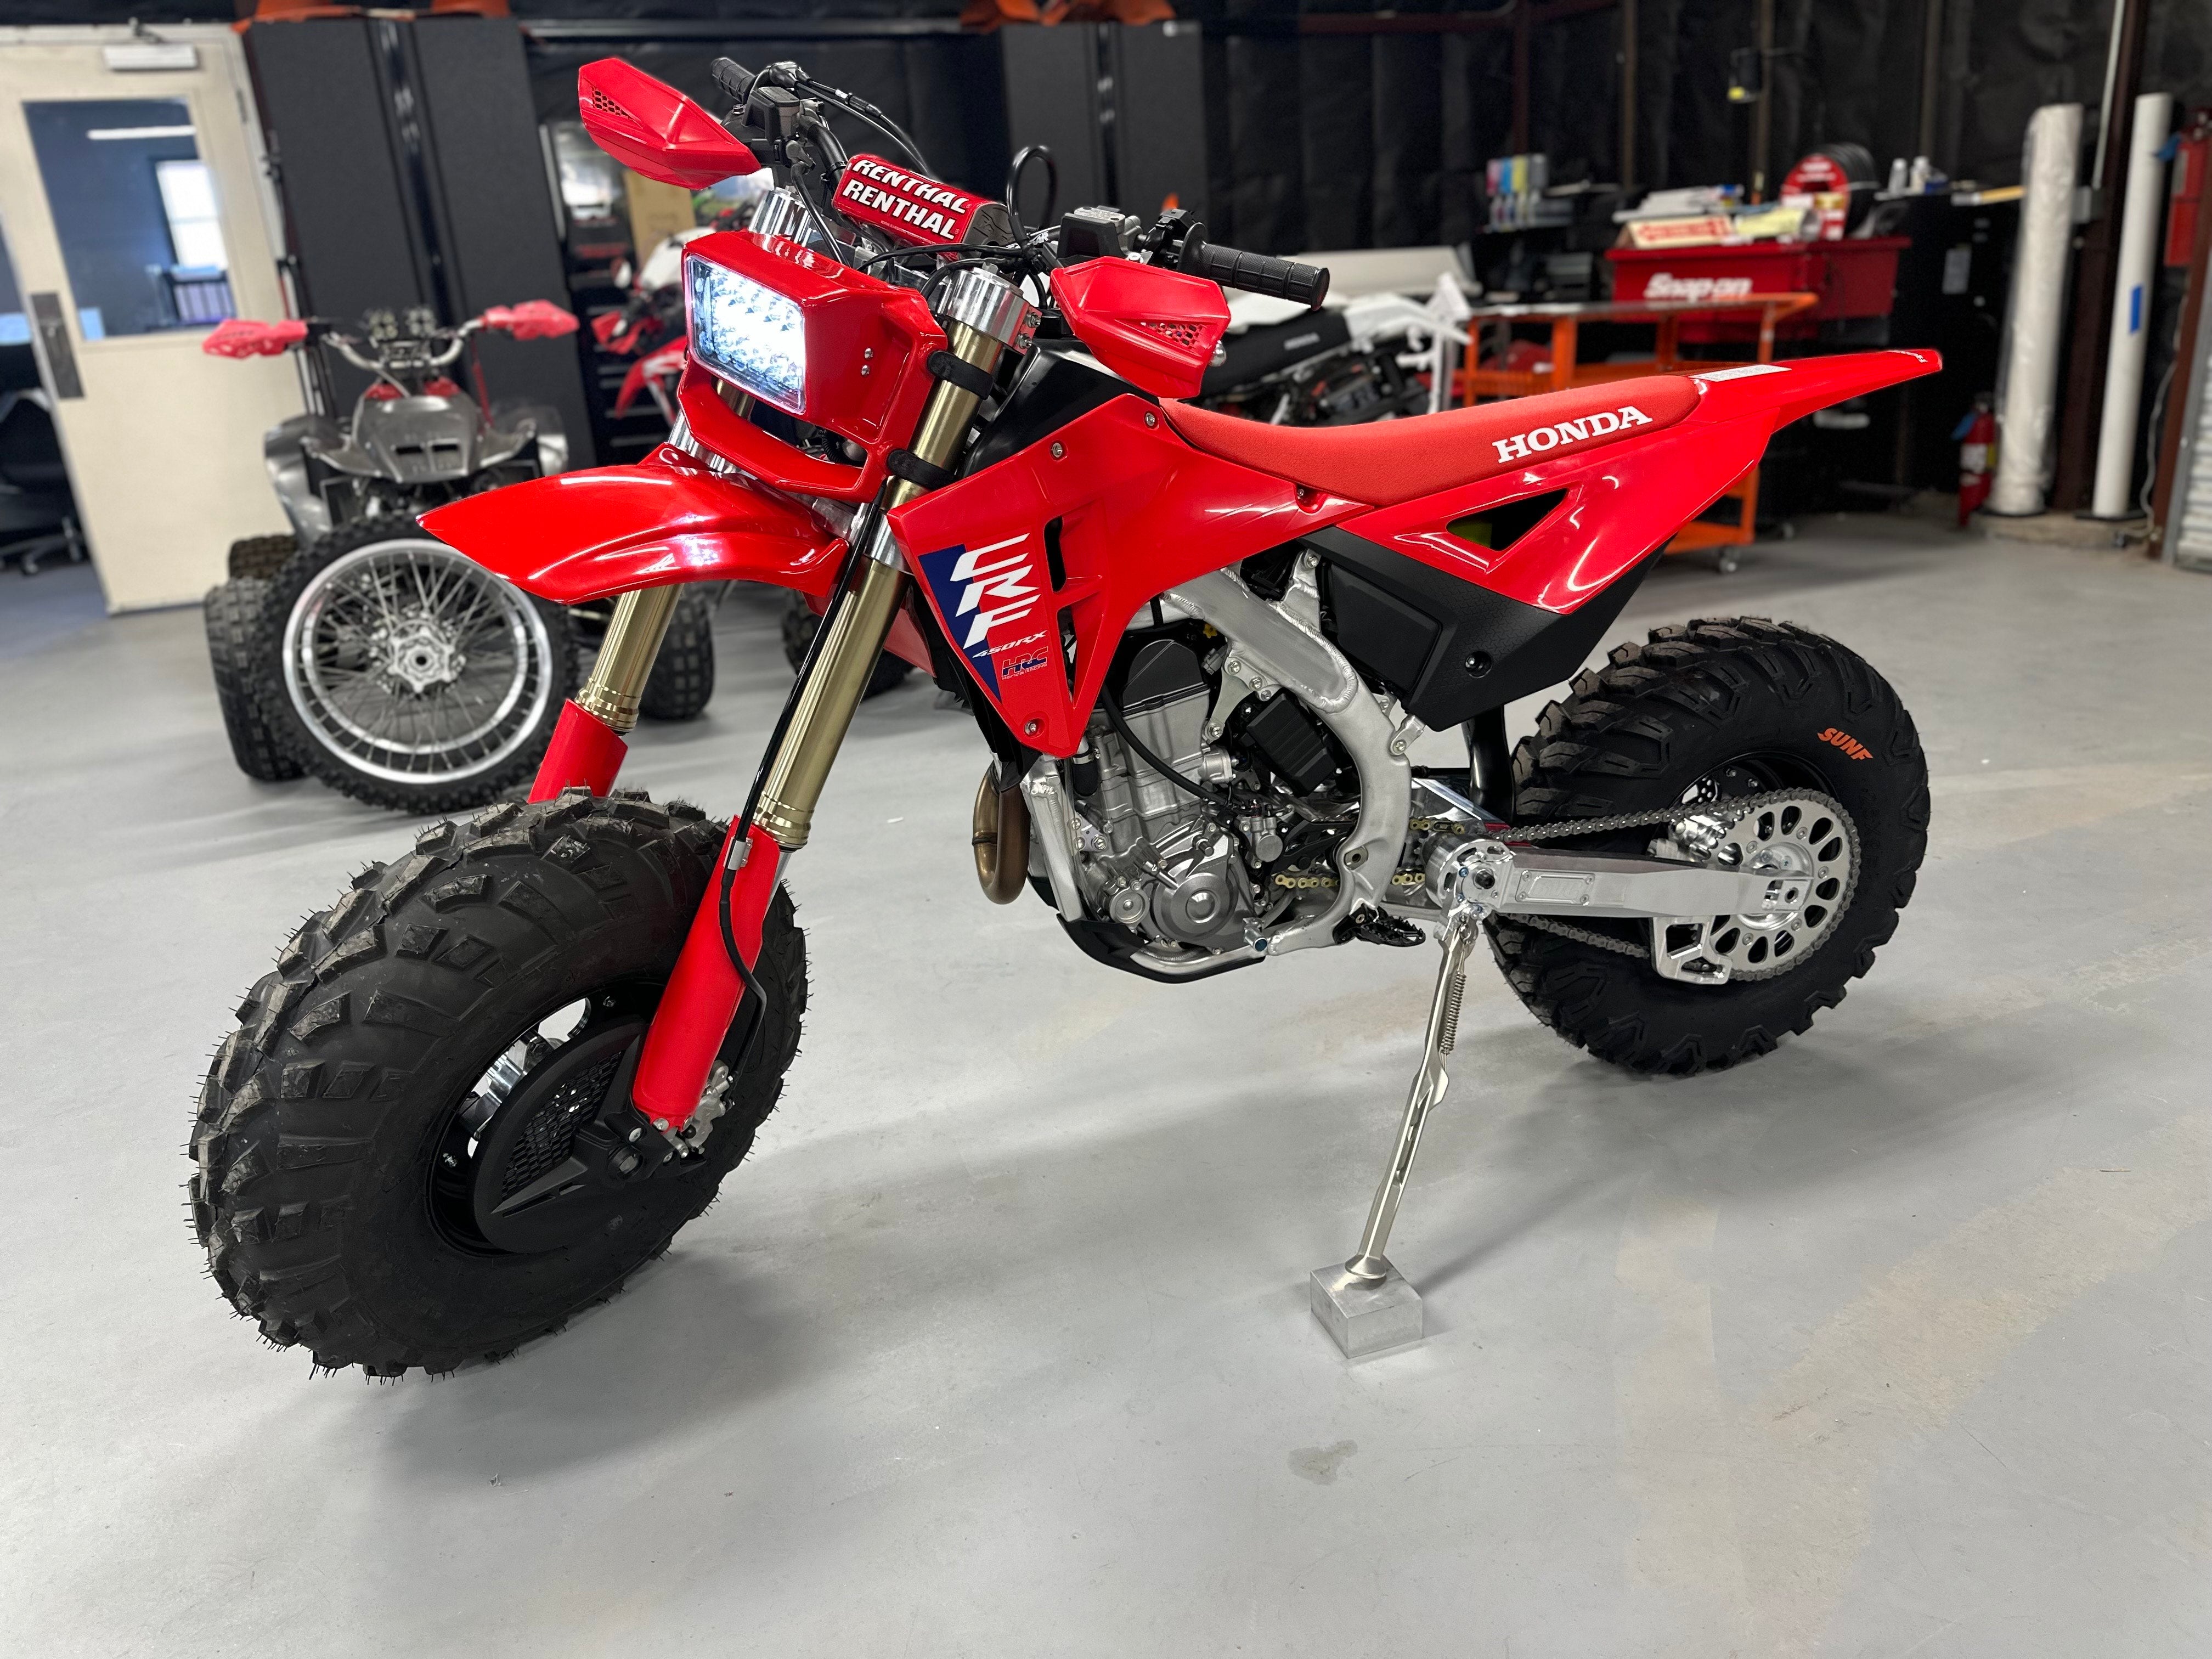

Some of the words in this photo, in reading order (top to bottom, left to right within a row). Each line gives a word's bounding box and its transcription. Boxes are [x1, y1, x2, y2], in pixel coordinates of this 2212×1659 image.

[852, 159, 969, 214] RENTHAL
[842, 179, 956, 240] RENTHAL
[1492, 405, 1653, 464] HONDA
[950, 532, 1042, 650] CRF
[972, 629, 1048, 658] 450RX
[1001, 646, 1049, 677] HRC
[1001, 670, 1024, 681] Honda
[1024, 663, 1048, 675] RACING
[1817, 727, 1874, 760] SUNF
